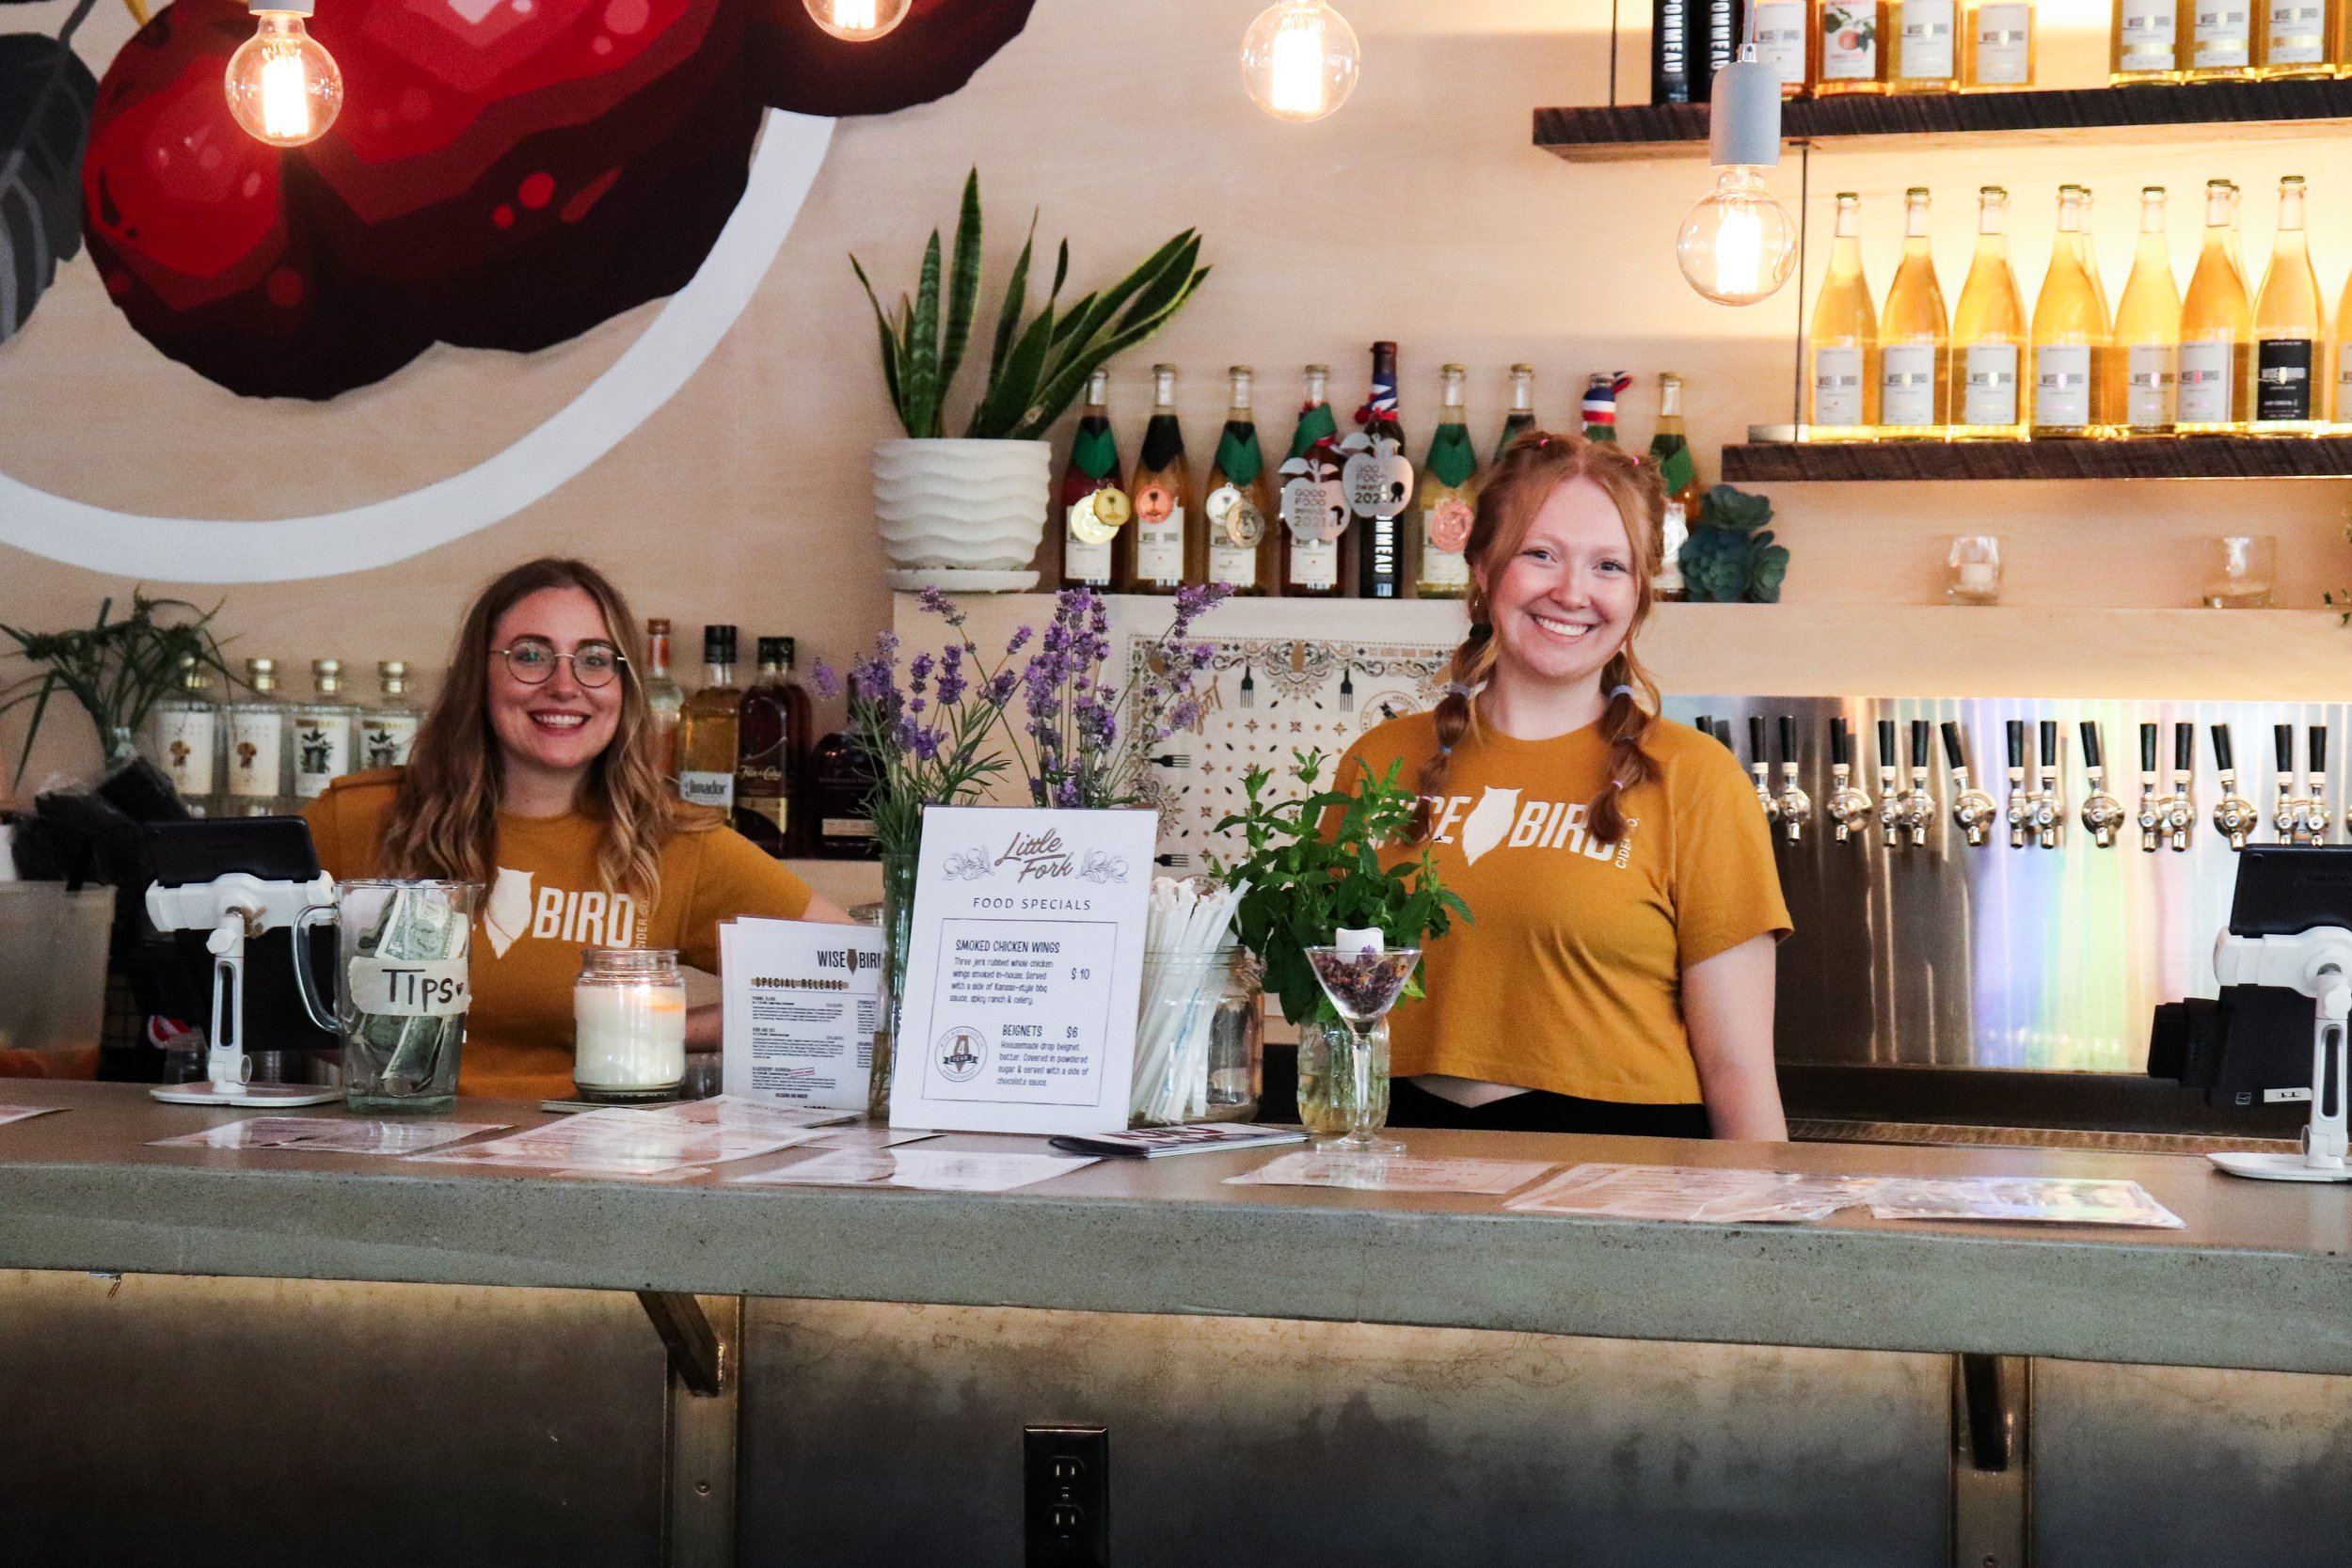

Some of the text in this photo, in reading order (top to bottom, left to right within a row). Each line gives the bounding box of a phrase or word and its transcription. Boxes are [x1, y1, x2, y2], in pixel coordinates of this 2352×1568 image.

[1711, 0, 1730, 71] OMMEAU
[1355, 492, 1387, 504] 202
[994, 827, 1064, 866] Little
[1017, 852, 1074, 883] Fork
[973, 897, 1091, 911] FOOD SPECIALS
[532, 886, 635, 948] BIRD
[955, 939, 1060, 954] SMOKED CHICKEN WINGS
[817, 950, 846, 968] WISE
[954, 957, 971, 965] Three
[973, 958, 985, 967] jerk
[988, 958, 1009, 967] rubbed
[952, 971, 970, 980] wings
[1025, 972, 1047, 980] Served
[1071, 967, 1090, 980] $ 10
[755, 976, 843, 990] SPECIAL RELEASE
[1002, 1023, 1078, 1038] BEIGNETS $6
[1040, 1042, 1055, 1051] drop
[1057, 1042, 1080, 1053] beignet
[1023, 1053, 1048, 1062] Covered
[1057, 1054, 1089, 1064] powdered
[997, 1066, 1015, 1074] sugar
[1024, 1066, 1044, 1074] served
[1046, 1067, 1061, 1075] with
